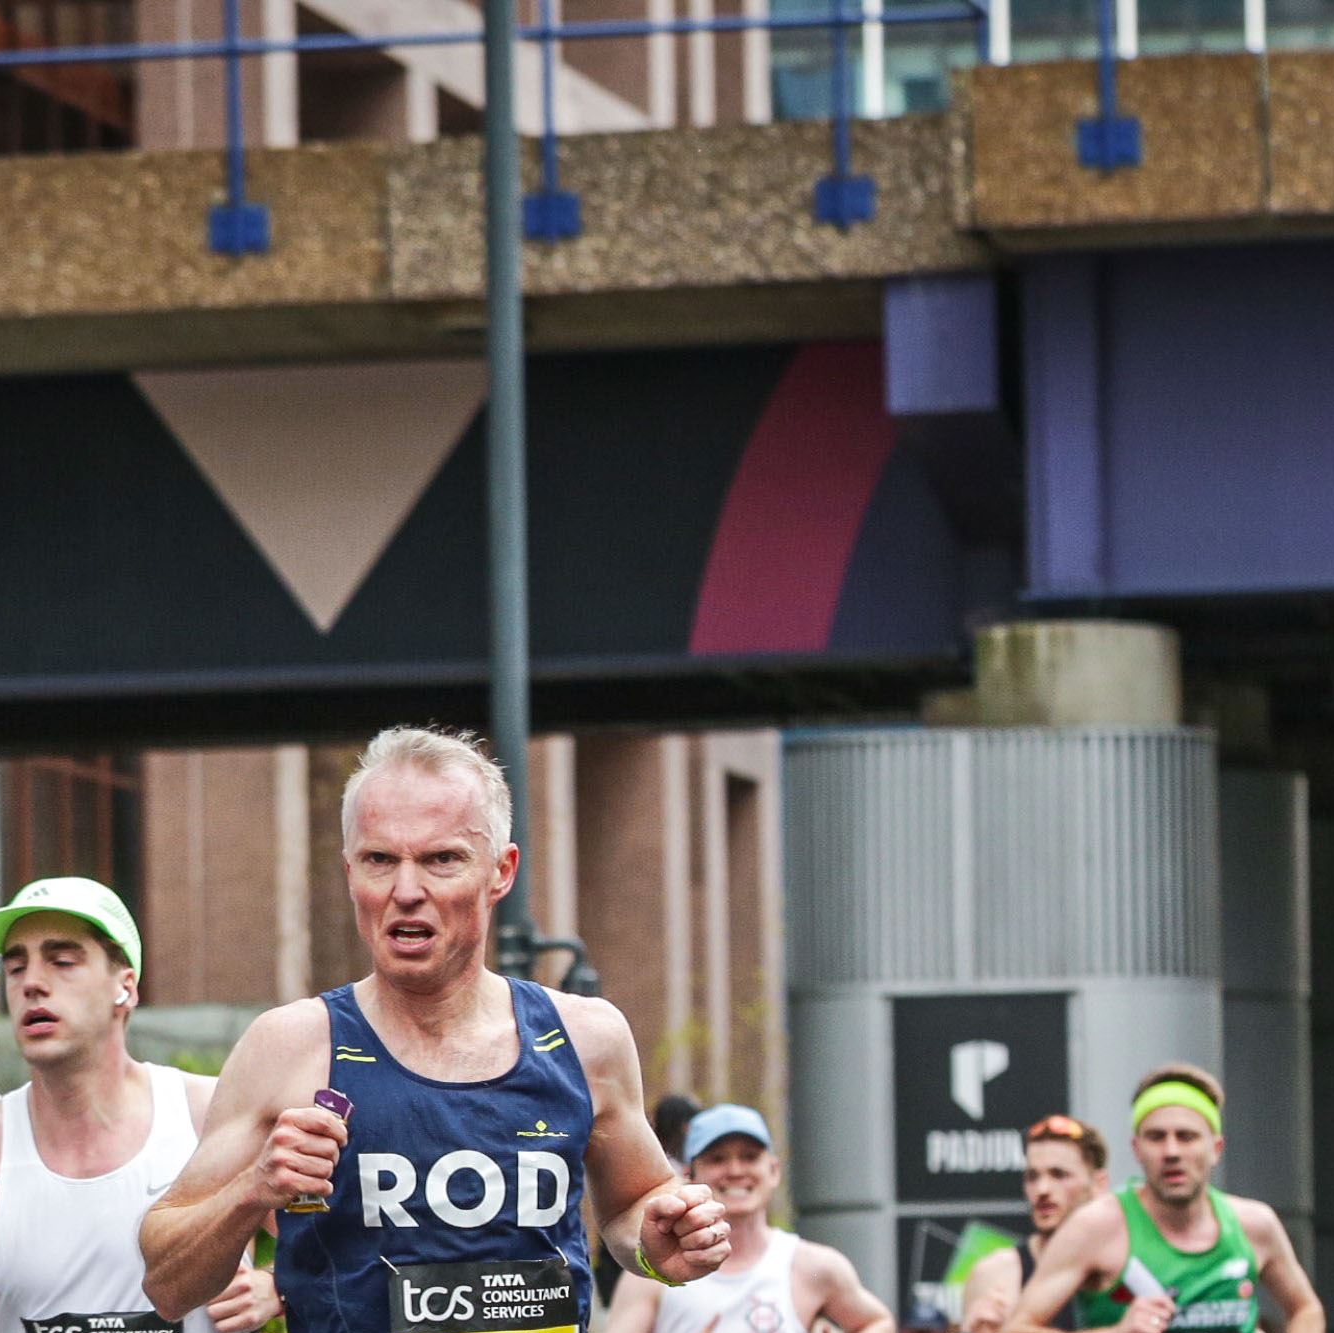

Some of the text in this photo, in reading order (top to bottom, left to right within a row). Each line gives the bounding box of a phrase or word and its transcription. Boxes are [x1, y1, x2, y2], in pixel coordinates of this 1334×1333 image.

[358, 1149, 570, 1228] ROD
[481, 1274, 525, 1287] TATA
[403, 1279, 475, 1323] tcs
[481, 1286, 570, 1304] CONSULTANCY
[483, 1305, 545, 1319] SERVICES
[88, 1318, 125, 1329] TATA
